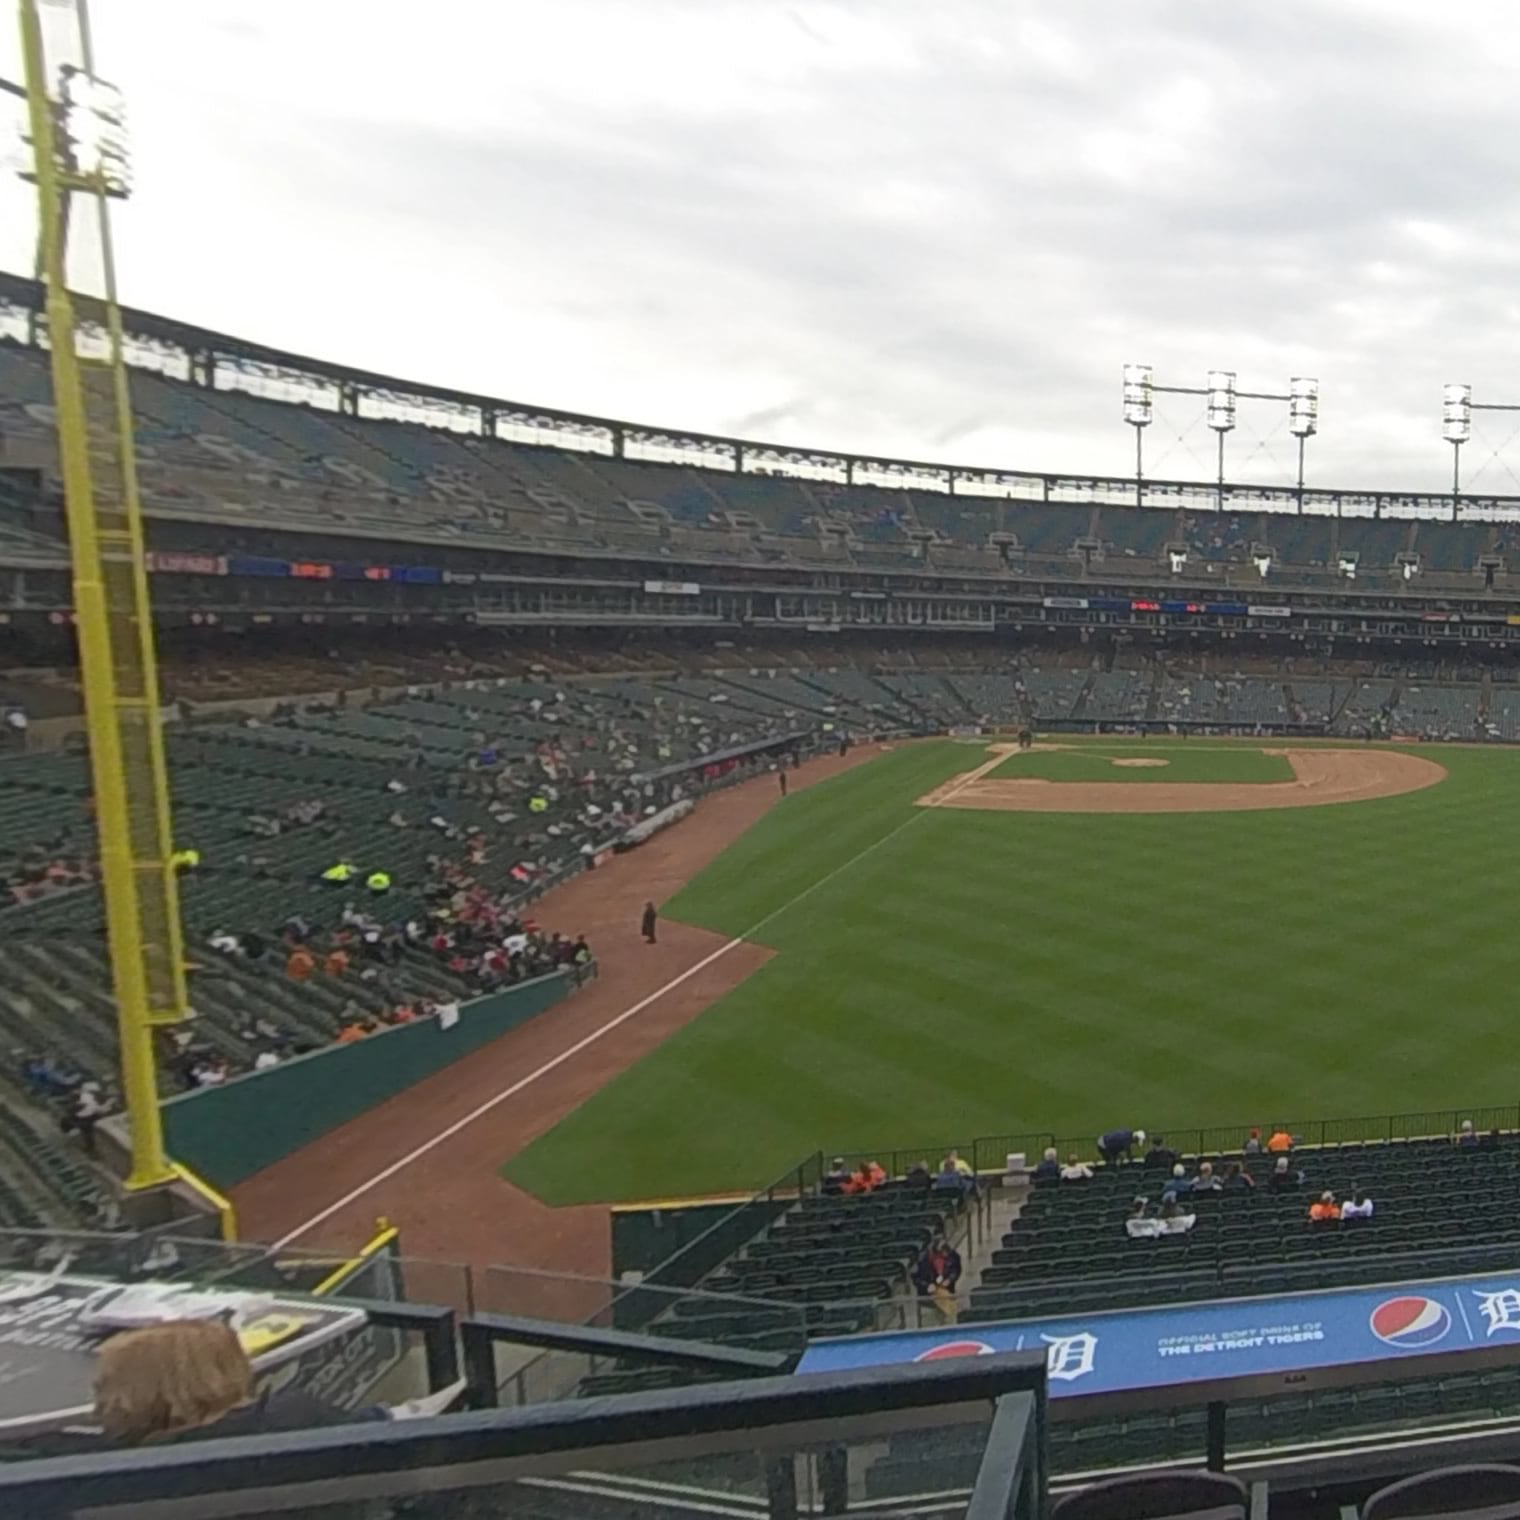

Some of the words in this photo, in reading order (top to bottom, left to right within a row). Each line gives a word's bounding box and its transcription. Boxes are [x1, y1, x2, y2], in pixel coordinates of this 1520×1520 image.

[1040, 1332, 1098, 1381] D
[1157, 1345, 1191, 1357] THE
[1193, 1336, 1264, 1354] DETROIT
[1266, 1330, 1326, 1346] TIGERS
